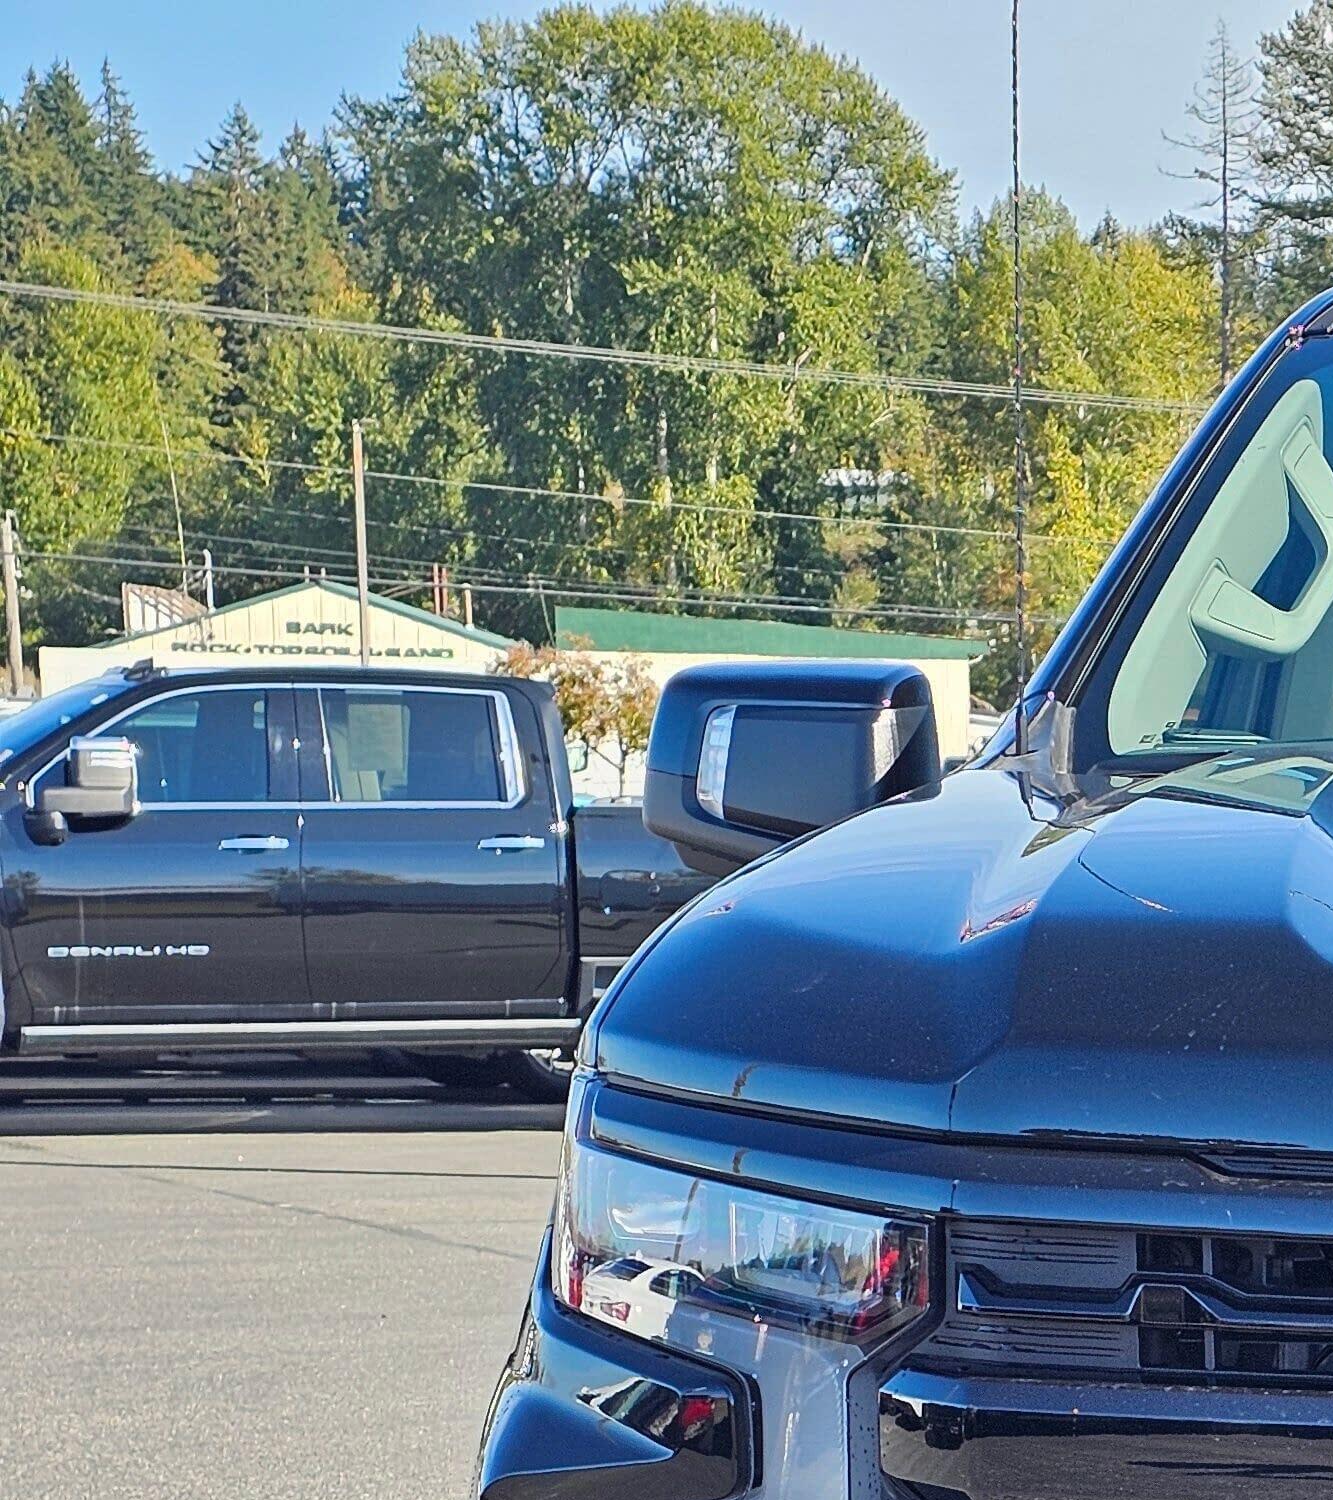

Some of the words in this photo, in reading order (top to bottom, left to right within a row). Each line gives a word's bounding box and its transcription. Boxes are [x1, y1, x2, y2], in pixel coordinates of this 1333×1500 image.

[285, 621, 354, 636] BARK
[47, 945, 161, 958] DENALI
[165, 944, 210, 956] HD
